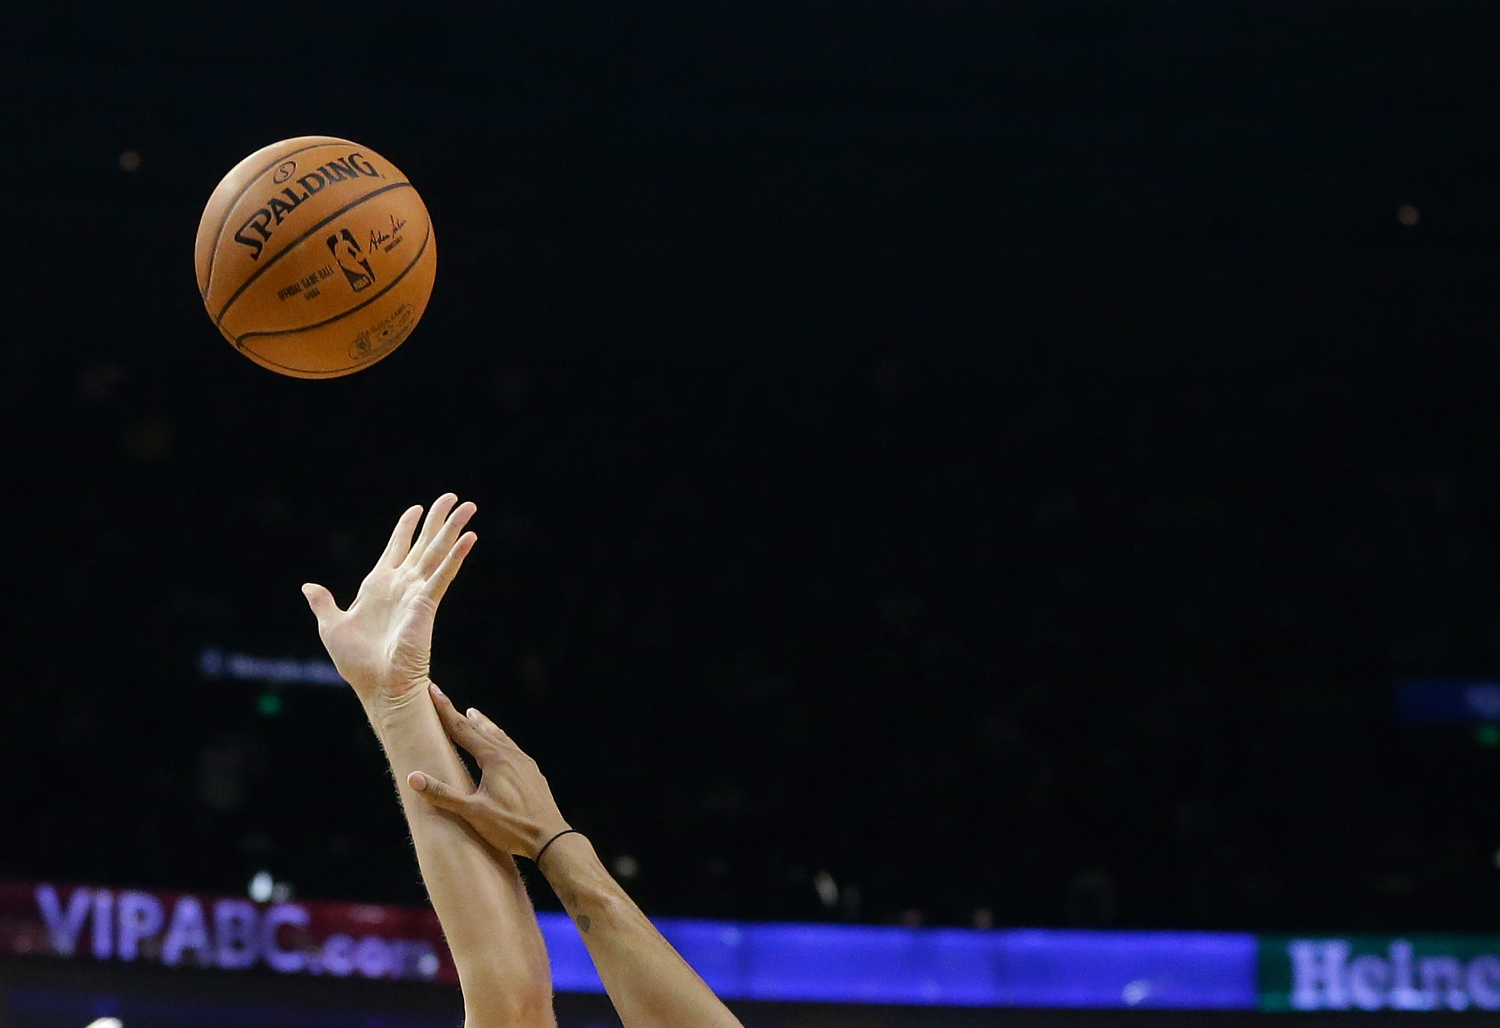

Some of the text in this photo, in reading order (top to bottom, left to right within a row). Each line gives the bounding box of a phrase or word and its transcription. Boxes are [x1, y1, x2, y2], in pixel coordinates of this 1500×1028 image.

[234, 152, 380, 261] SPALDING
[301, 272, 319, 288] GAME
[317, 264, 335, 279] BALL
[352, 275, 369, 290] NBA
